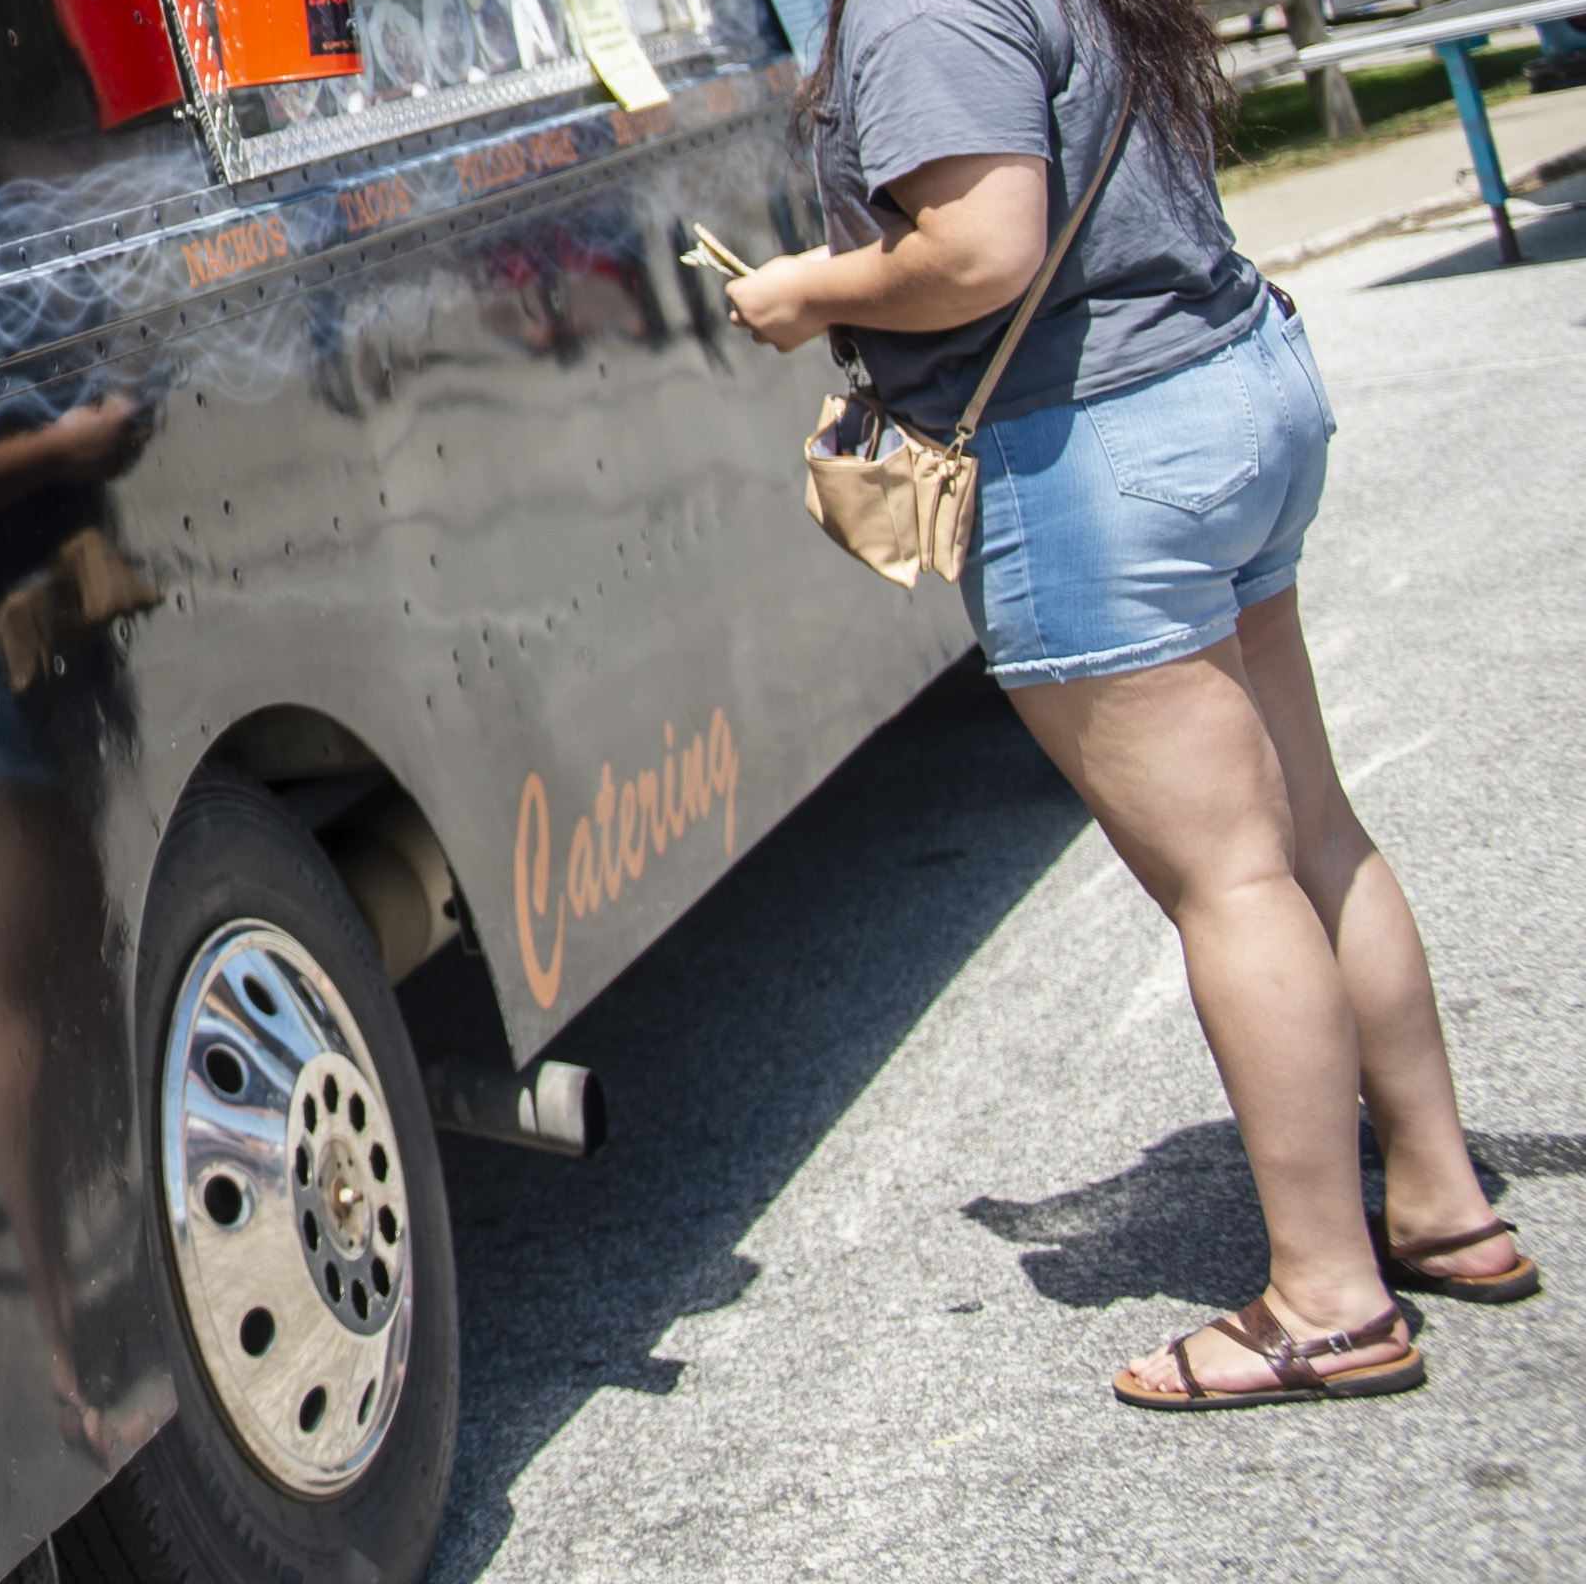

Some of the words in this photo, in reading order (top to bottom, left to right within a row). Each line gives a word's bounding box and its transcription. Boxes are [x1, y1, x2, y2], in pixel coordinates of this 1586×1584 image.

[181, 217, 287, 288] NACHOS
[338, 177, 411, 232] TACOS
[514, 706, 739, 1012] Catering
